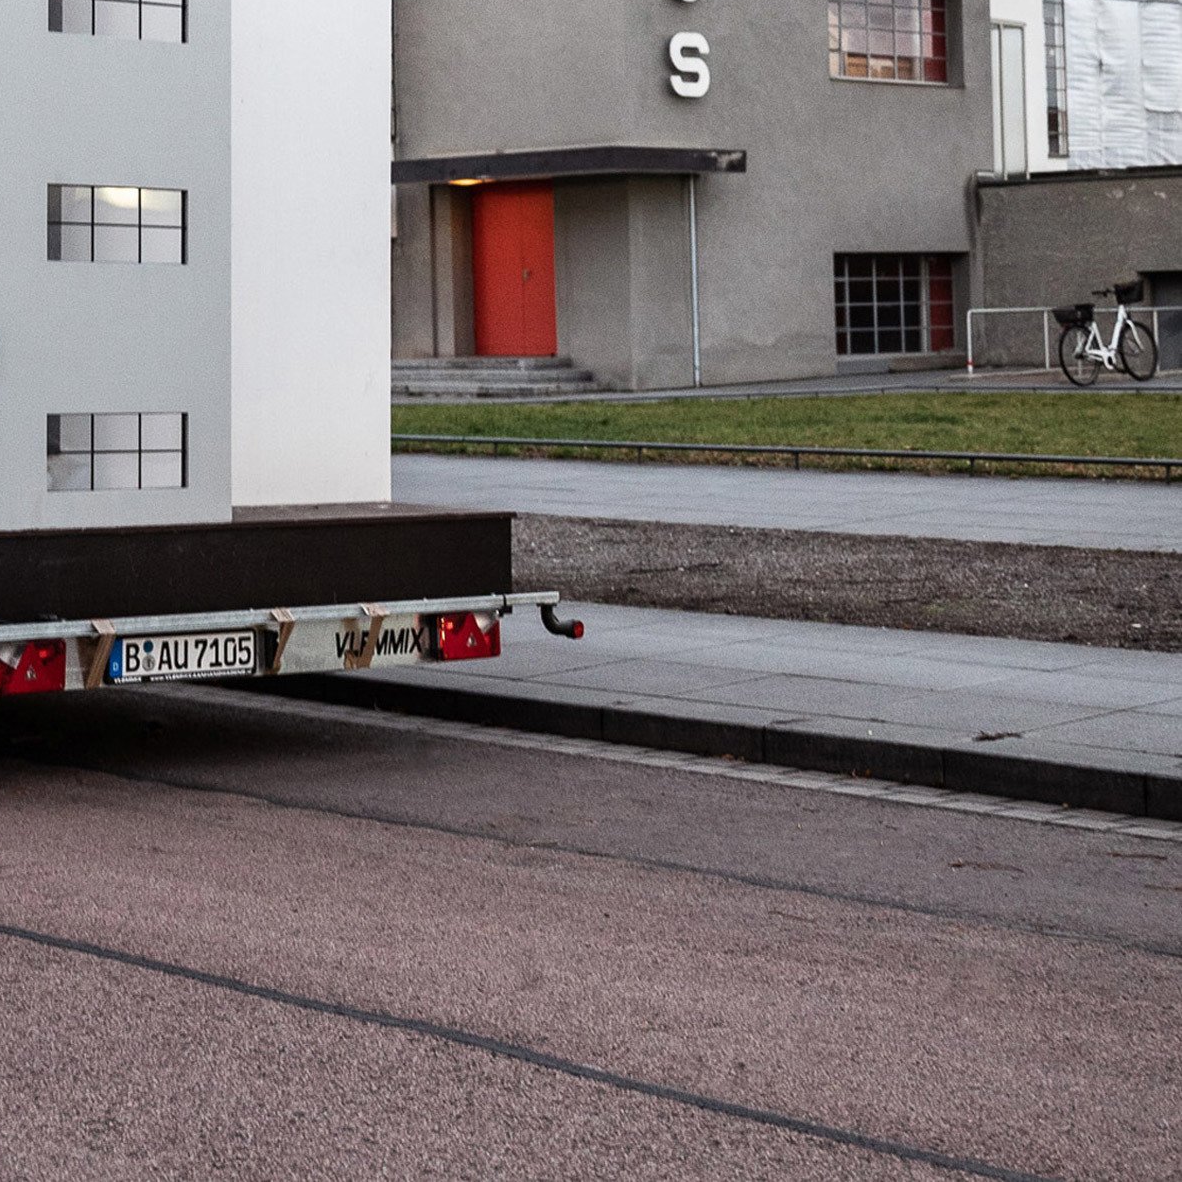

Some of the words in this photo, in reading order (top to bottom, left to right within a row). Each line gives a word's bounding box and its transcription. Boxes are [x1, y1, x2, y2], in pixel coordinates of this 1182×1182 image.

[125, 642, 140, 672] B
[158, 640, 188, 671] AU
[194, 636, 251, 668] 7105
